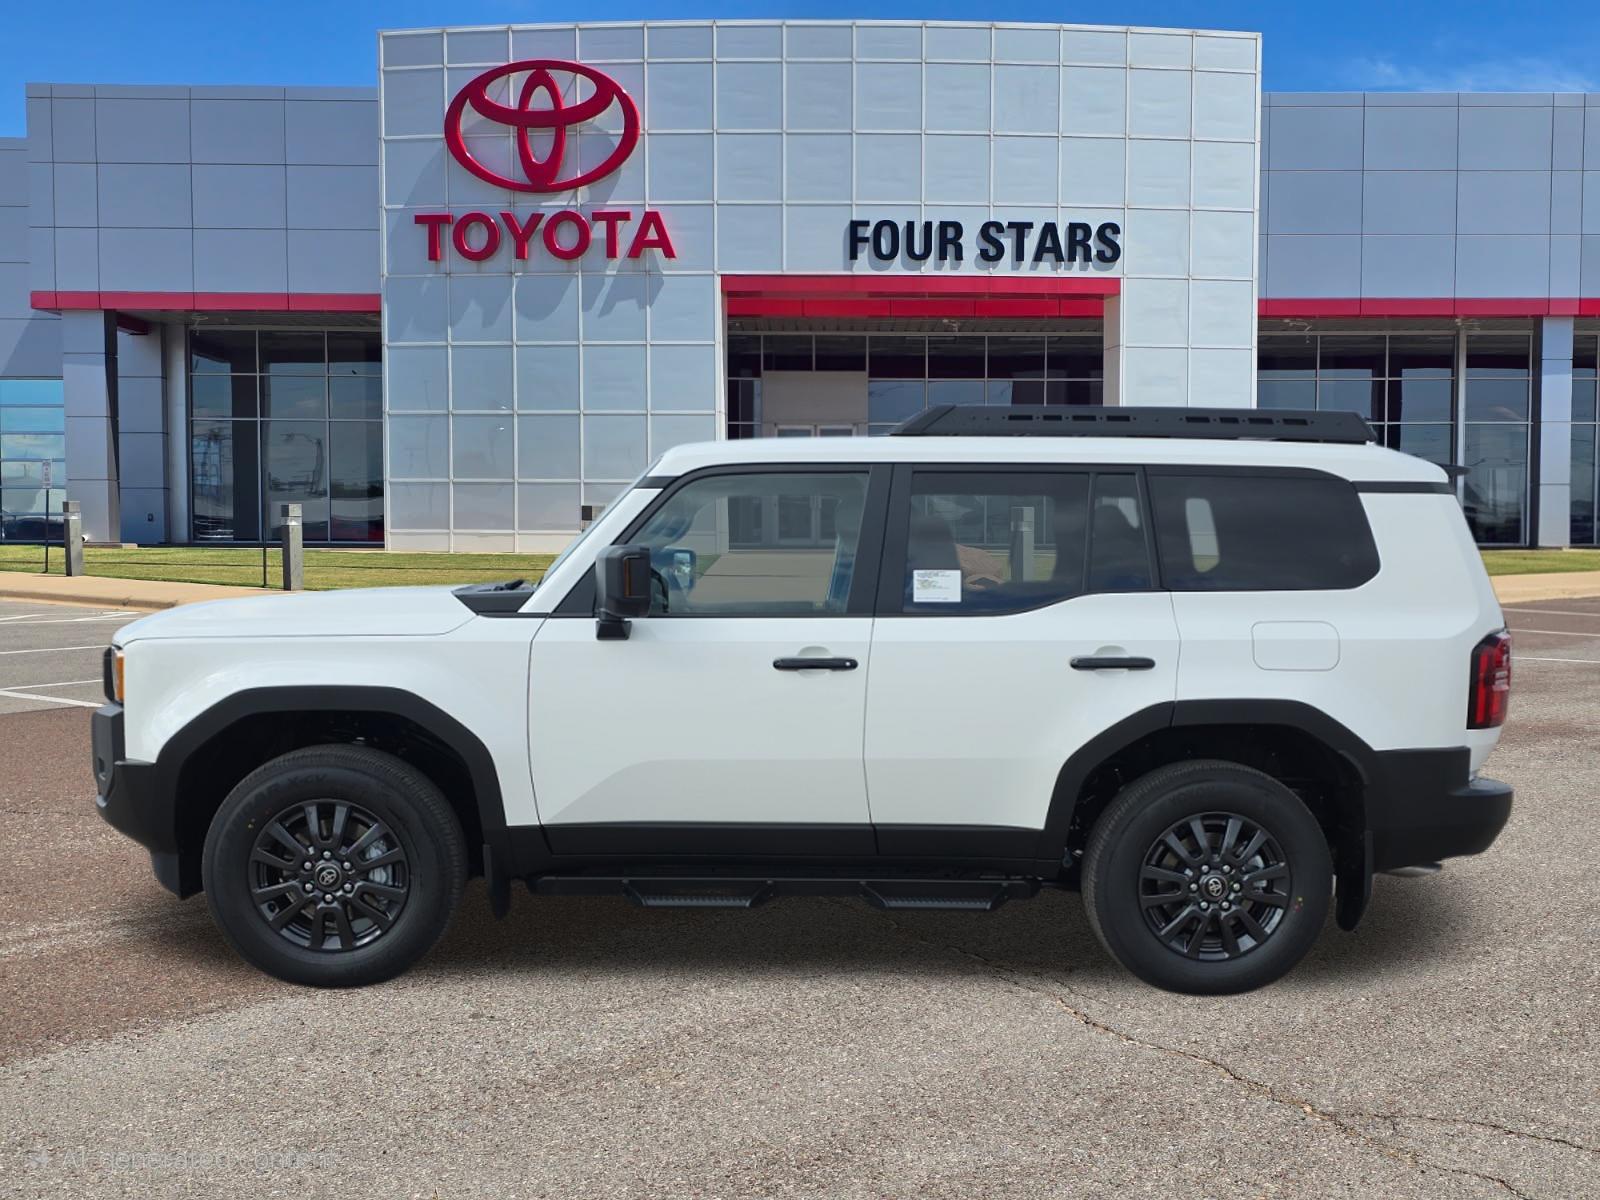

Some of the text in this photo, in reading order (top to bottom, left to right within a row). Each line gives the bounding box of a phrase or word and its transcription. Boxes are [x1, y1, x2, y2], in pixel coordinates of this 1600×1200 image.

[414, 210, 677, 262] TOYOTA
[849, 219, 1122, 263] FOUR STARS
